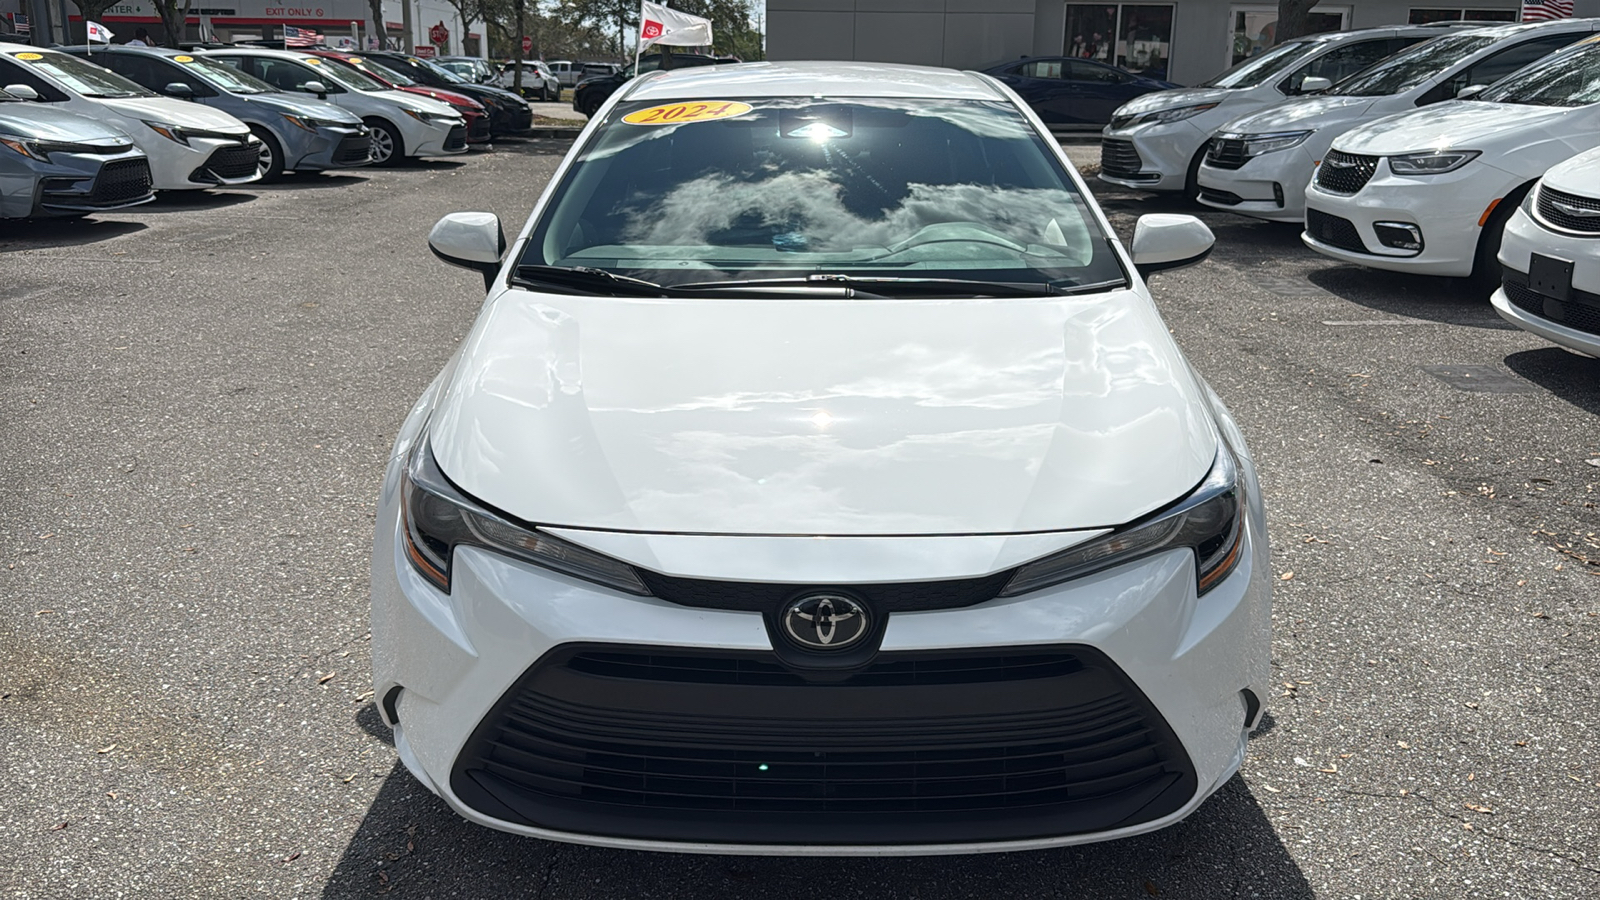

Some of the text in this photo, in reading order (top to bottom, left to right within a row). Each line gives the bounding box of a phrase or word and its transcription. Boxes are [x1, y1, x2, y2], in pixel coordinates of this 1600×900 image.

[265, 7, 312, 16] EXIT ONLY
[638, 103, 733, 123] 2024
